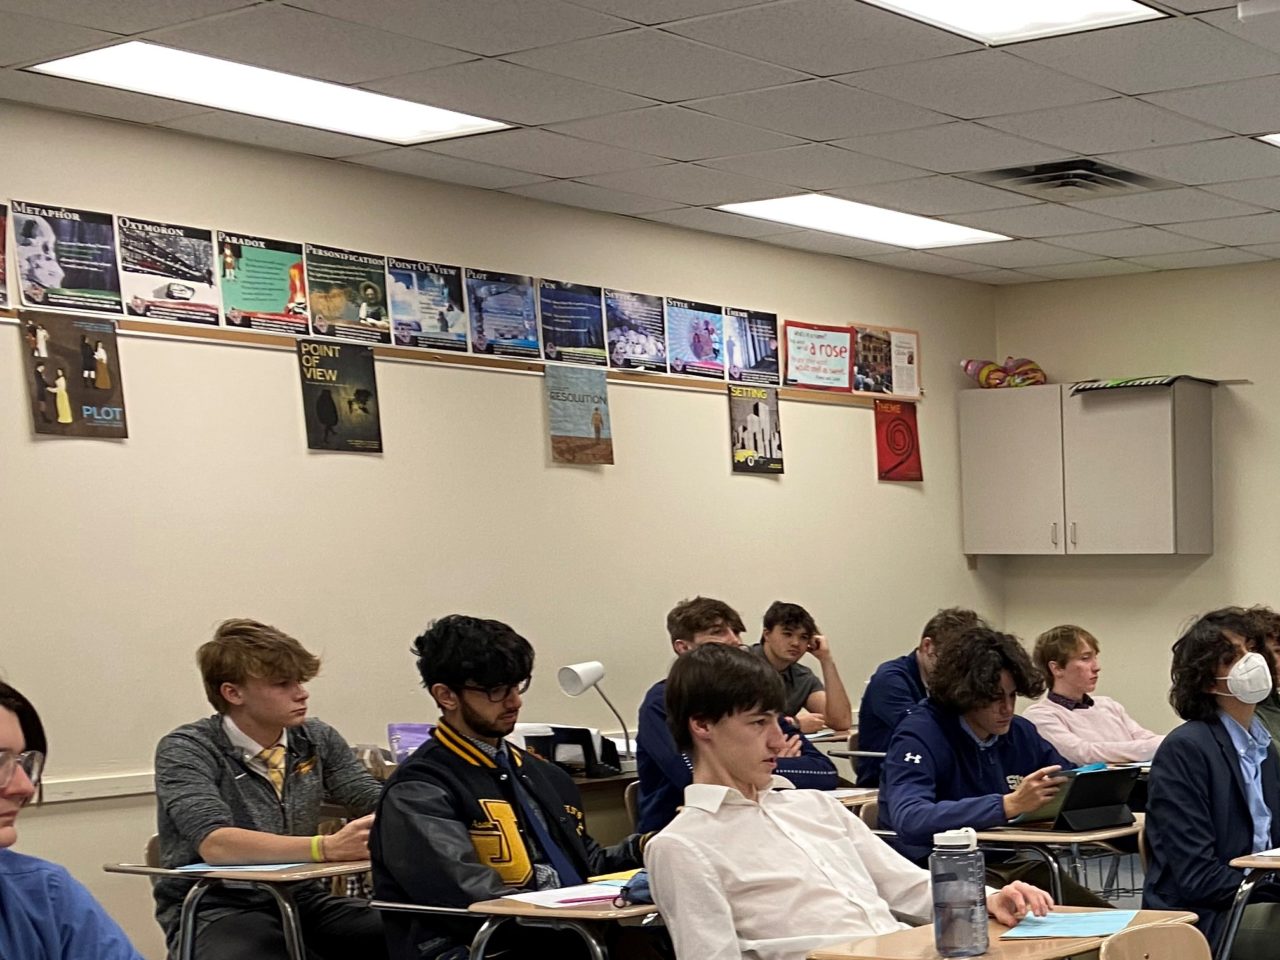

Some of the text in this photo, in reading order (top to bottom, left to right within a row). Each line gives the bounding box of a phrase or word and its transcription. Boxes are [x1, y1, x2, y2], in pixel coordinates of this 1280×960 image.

[13, 202, 81, 222] METAPHOR
[119, 217, 184, 237] OXYMORON
[218, 231, 266, 249] PARADOX
[306, 244, 386, 267] PERSONIFICATION
[388, 258, 416, 272] POINT
[432, 265, 457, 277] VIEW
[466, 270, 488, 281] PLOT
[301, 342, 341, 358] POINT
[809, 342, 849, 359] a rose
[302, 355, 321, 368] OF
[303, 367, 338, 381] VIEW
[550, 391, 608, 405] RESOLUTION
[731, 386, 768, 400] SETTING
[82, 405, 122, 420] PLOT
